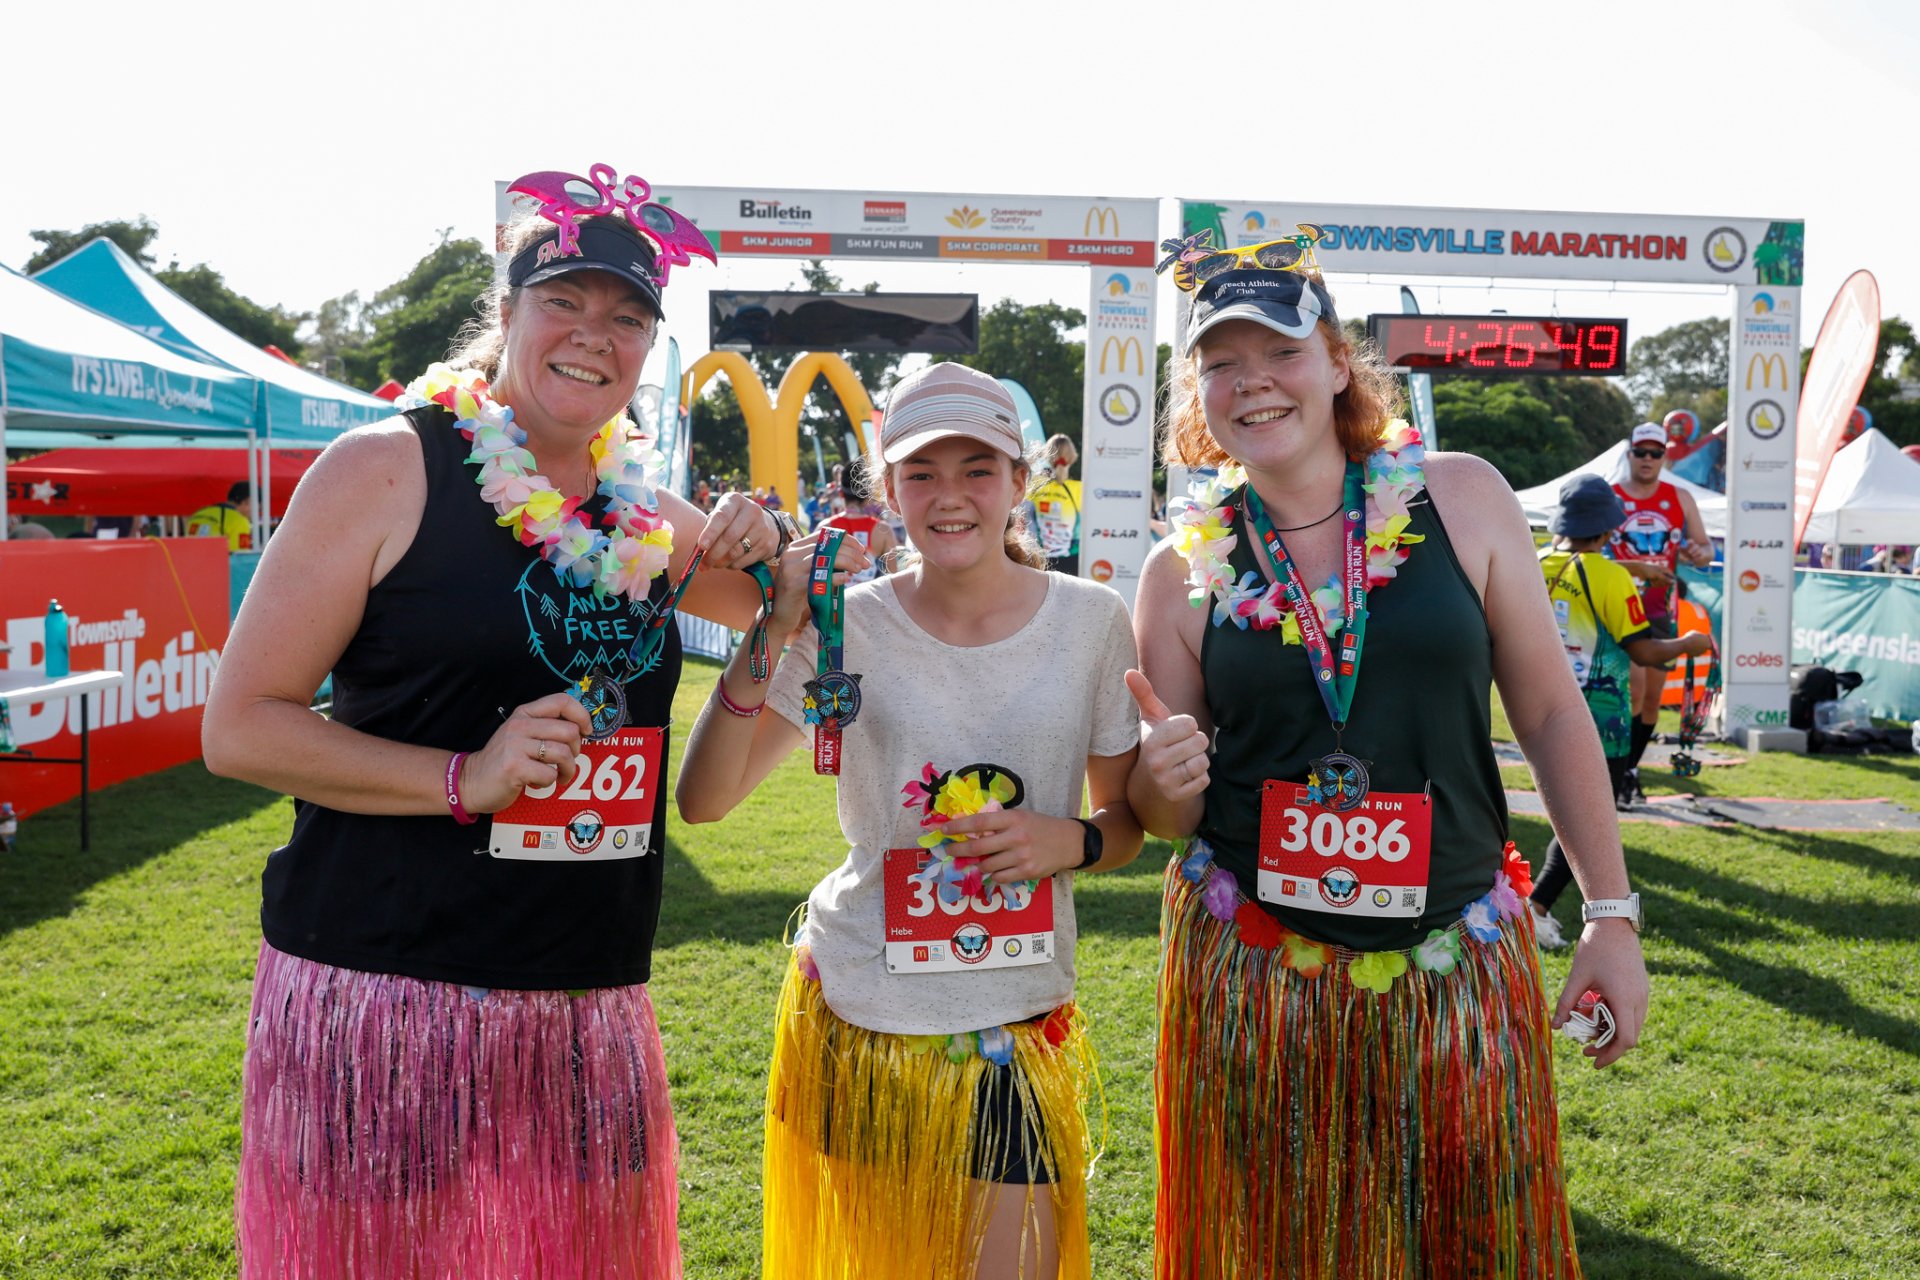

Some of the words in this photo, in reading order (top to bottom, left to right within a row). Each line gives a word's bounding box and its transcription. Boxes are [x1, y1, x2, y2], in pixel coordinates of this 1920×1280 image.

[739, 199, 812, 220] Bulletin
[991, 208, 1042, 217] Queensland
[991, 215, 1026, 225] Country
[742, 236, 767, 247] 5KM
[769, 237, 813, 248] JUNIOR
[847, 239, 872, 249] 5KM
[873, 239, 897, 249] FUN
[899, 240, 924, 250] RUN
[947, 241, 971, 252] 5KM
[974, 242, 1041, 253] CORPORATE
[1068, 244, 1101, 255] 2.5KM
[1103, 245, 1134, 256] HERO
[1320, 224, 1505, 255] OWNSVILLE
[1511, 231, 1687, 261] MARATHON
[1236, 287, 1256, 295] Club
[1248, 279, 1280, 288] Athletic
[72, 355, 103, 396] IT'S
[104, 359, 144, 401] LIVE!
[1091, 528, 1139, 539] POLAR
[1739, 539, 1784, 549] POLAR
[1353, 545, 1362, 567] RUN
[1353, 568, 1362, 589] FUN
[1557, 579, 1581, 598] CREW
[568, 591, 620, 617] AND
[1354, 591, 1363, 610] 5km
[68, 608, 146, 647] Townsville
[1293, 598, 1308, 618] FUN
[1301, 618, 1316, 642] RUN
[564, 617, 635, 645] FREE
[1316, 632, 1328, 657] FESTIVAL
[1735, 651, 1783, 668] coles
[622, 736, 644, 747] RUN
[824, 740, 834, 765] RUN
[1375, 801, 1403, 811] RUN
[1280, 807, 1411, 863] 3086
[1263, 856, 1279, 867] Red
[890, 927, 913, 936] Hebe
